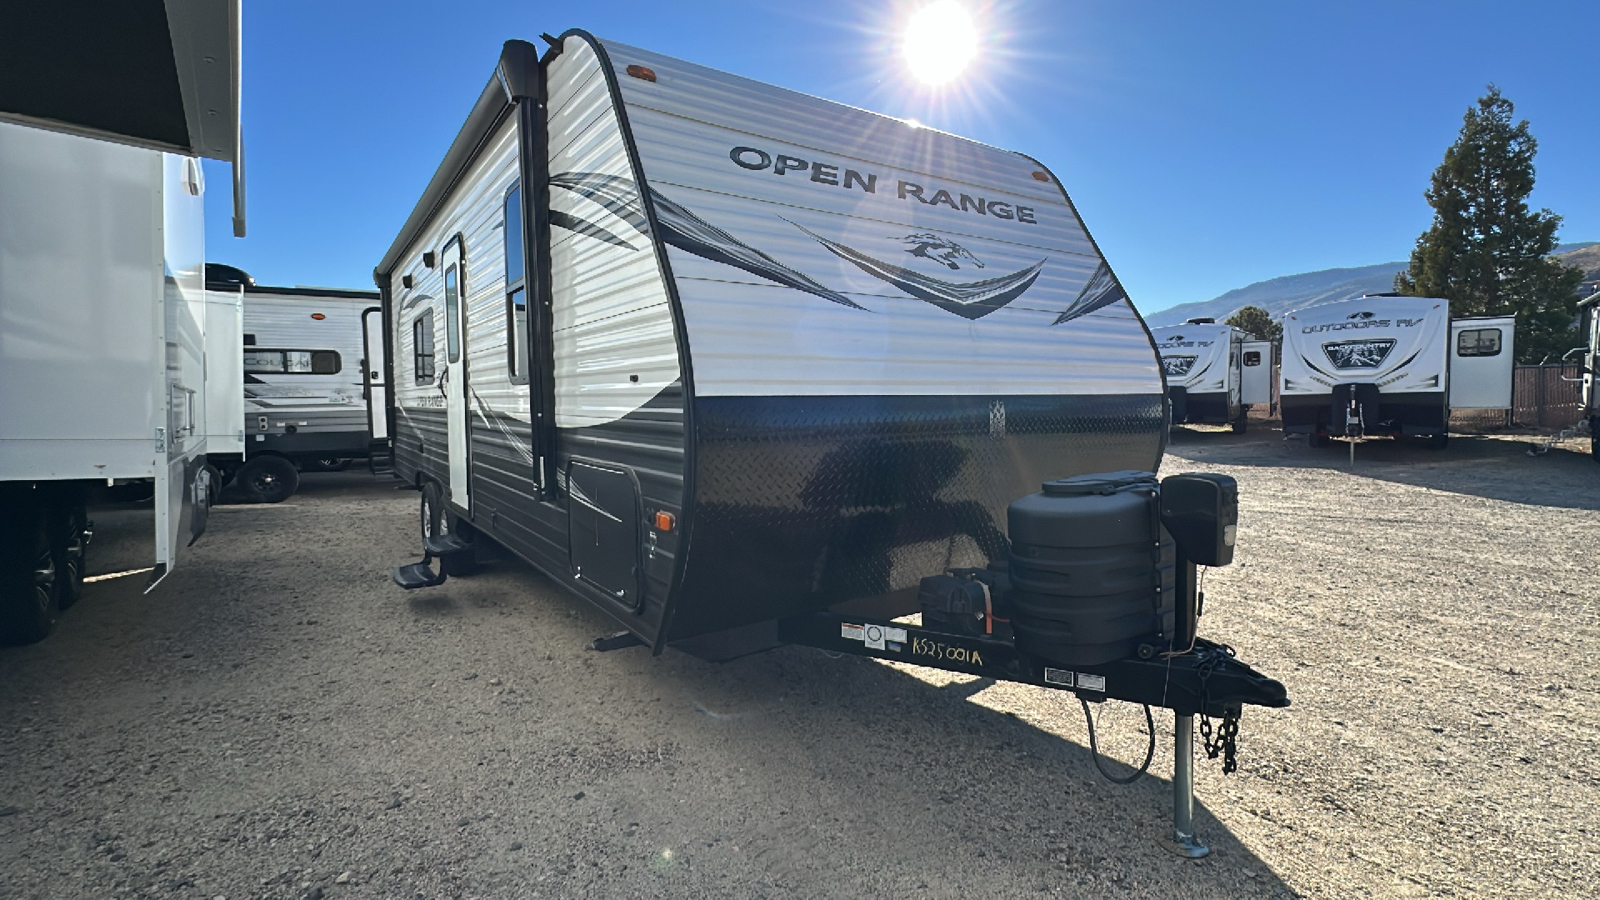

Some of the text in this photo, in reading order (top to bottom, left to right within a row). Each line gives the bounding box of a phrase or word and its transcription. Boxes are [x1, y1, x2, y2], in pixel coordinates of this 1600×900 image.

[729, 146, 1037, 225] OPEN RANGE
[1302, 318, 1424, 334] OUTDOORS RV
[1157, 341, 1195, 349] DOORS
[1327, 342, 1391, 351] BACKCOUNTRY
